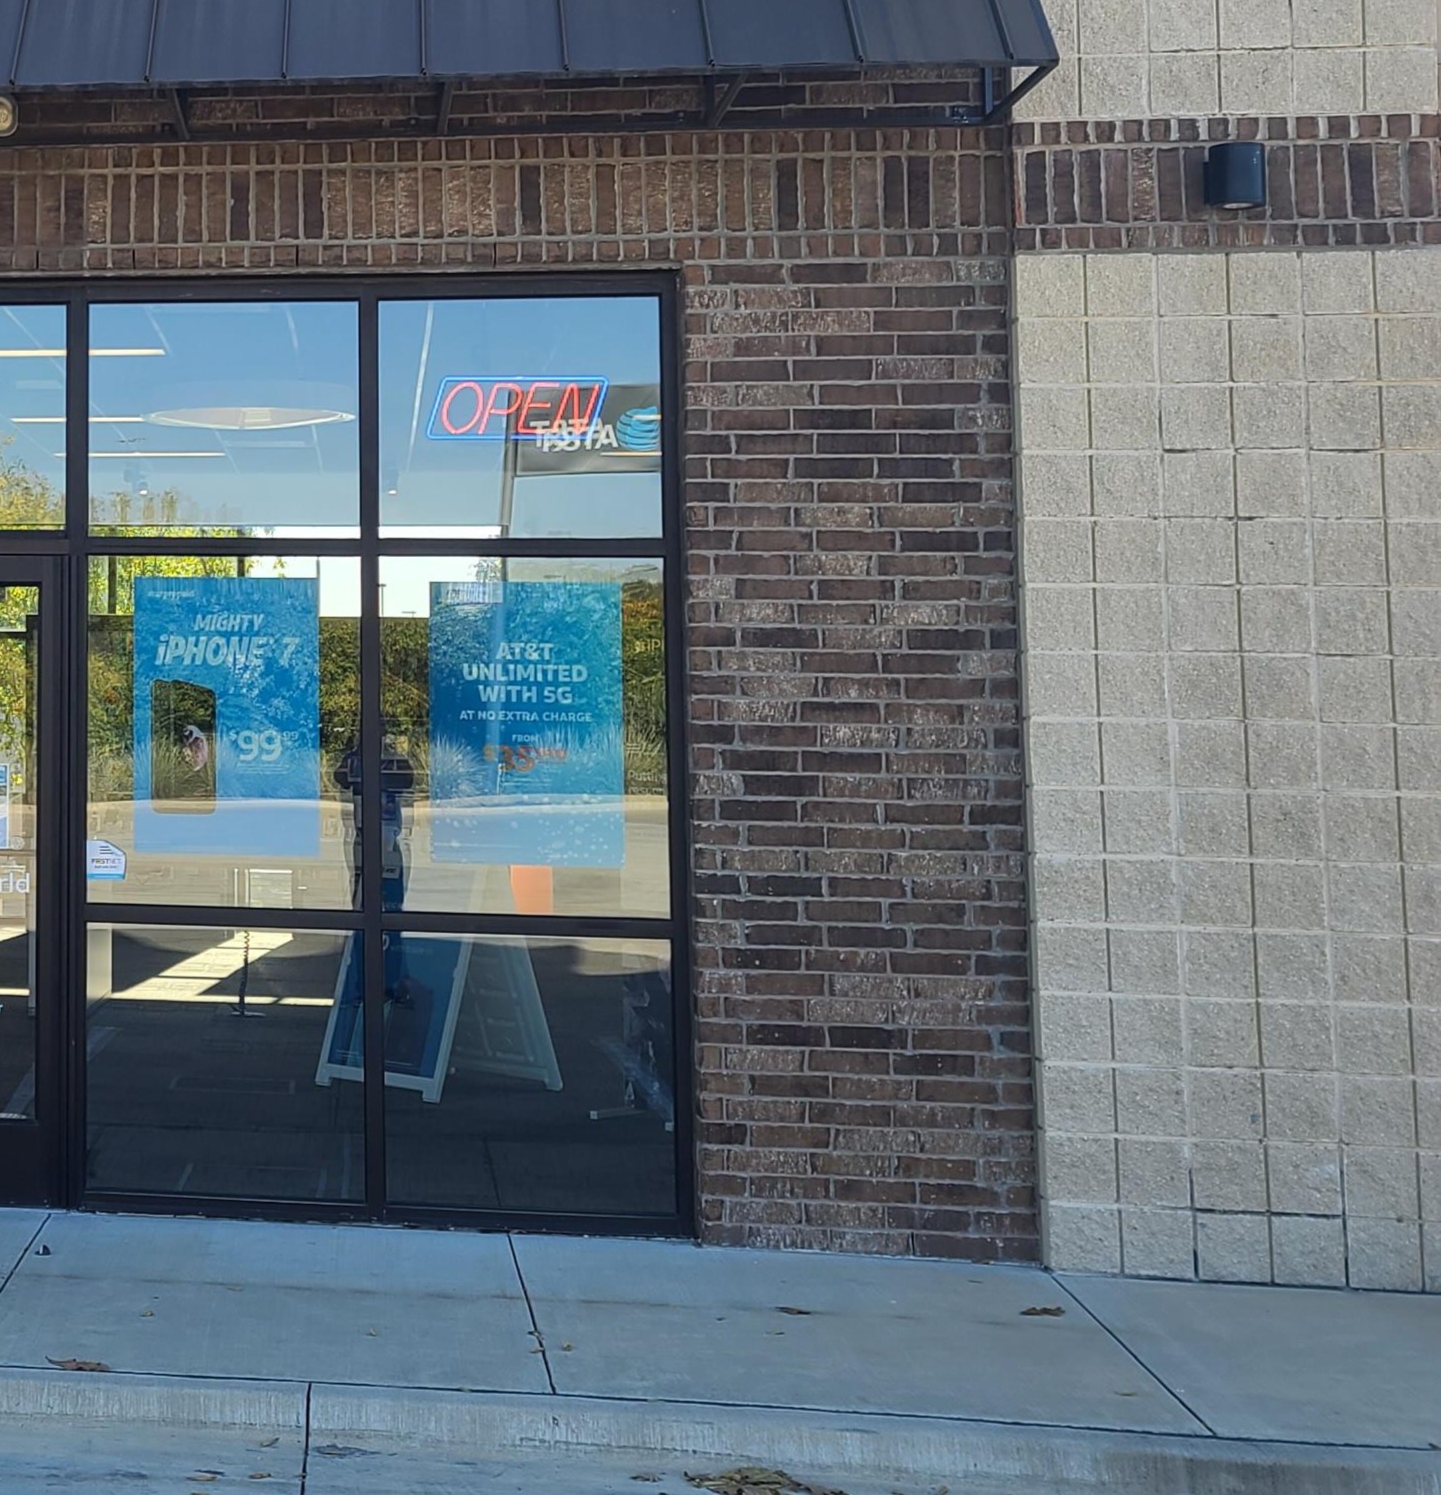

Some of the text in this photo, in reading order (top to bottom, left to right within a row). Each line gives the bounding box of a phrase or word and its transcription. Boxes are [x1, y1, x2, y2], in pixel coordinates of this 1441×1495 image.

[440, 381, 601, 435] OPEN
[193, 613, 265, 632] MIGHTY
[281, 637, 300, 666] 7
[496, 642, 555, 660] AT&T
[462, 663, 588, 683] UNLIMITED
[478, 685, 573, 704] WITH 5G
[459, 710, 593, 722] AT NO EXTRA CHARGE
[511, 734, 540, 742] FROM
